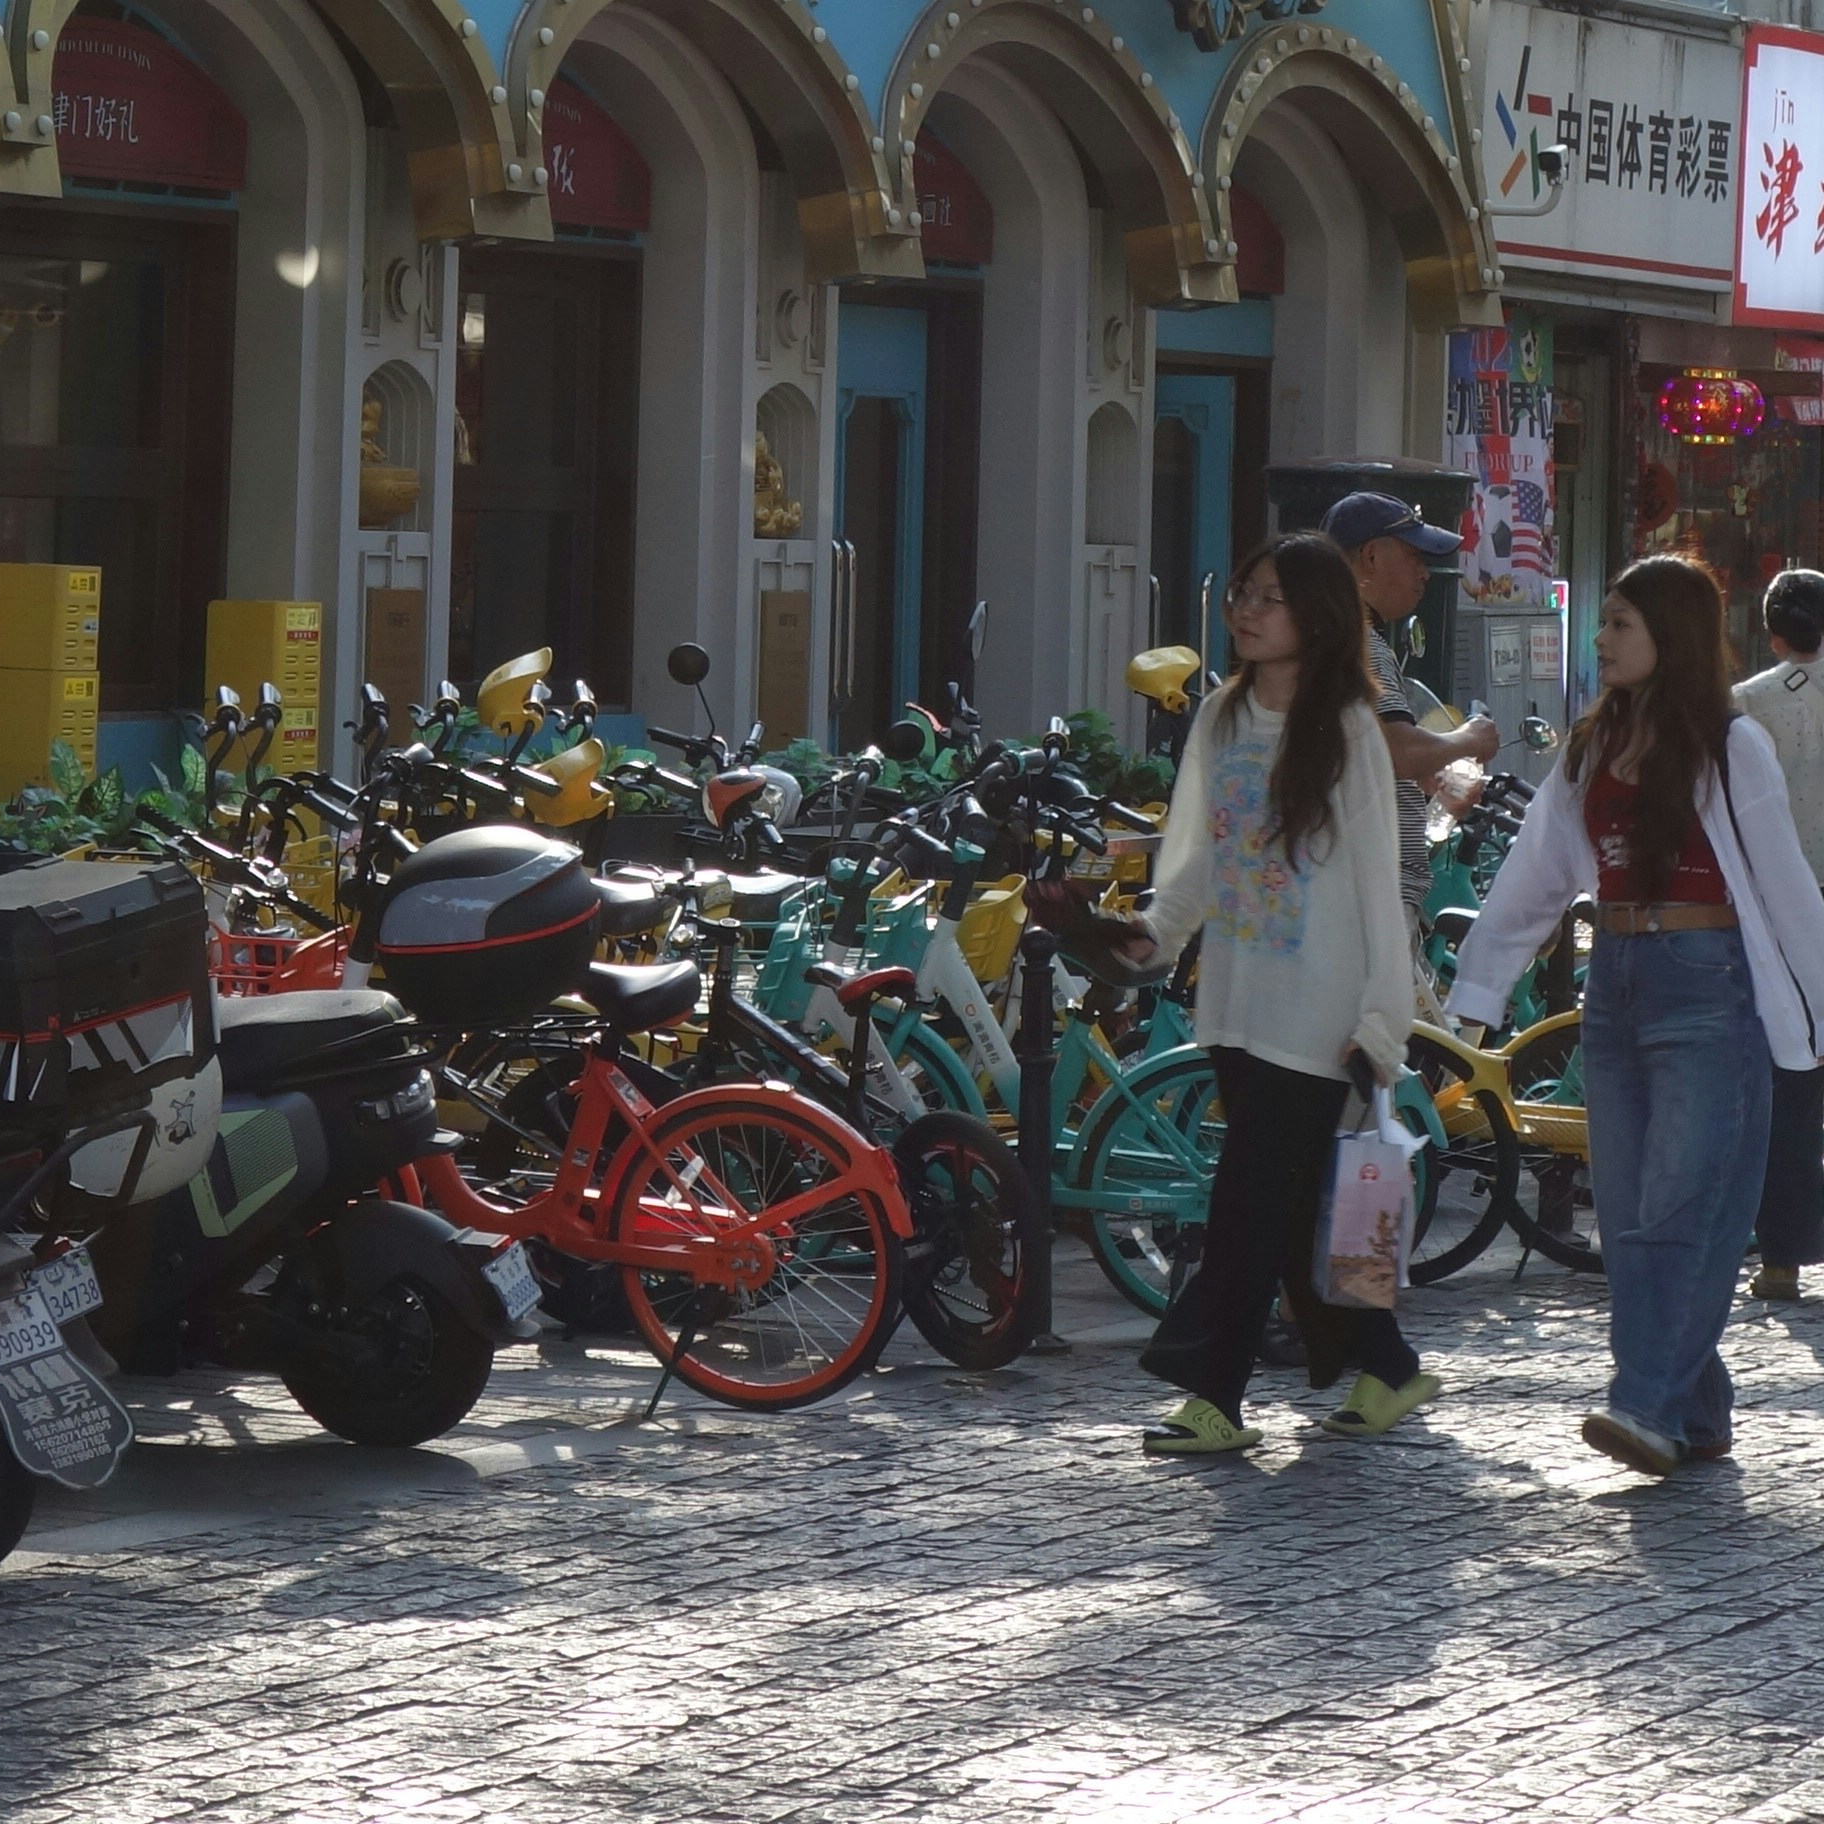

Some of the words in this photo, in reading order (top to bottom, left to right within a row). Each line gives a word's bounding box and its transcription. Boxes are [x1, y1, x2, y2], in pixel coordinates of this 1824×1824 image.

[1555, 92, 1732, 204] 中国体育彩票
[917, 194, 952, 227] 画社
